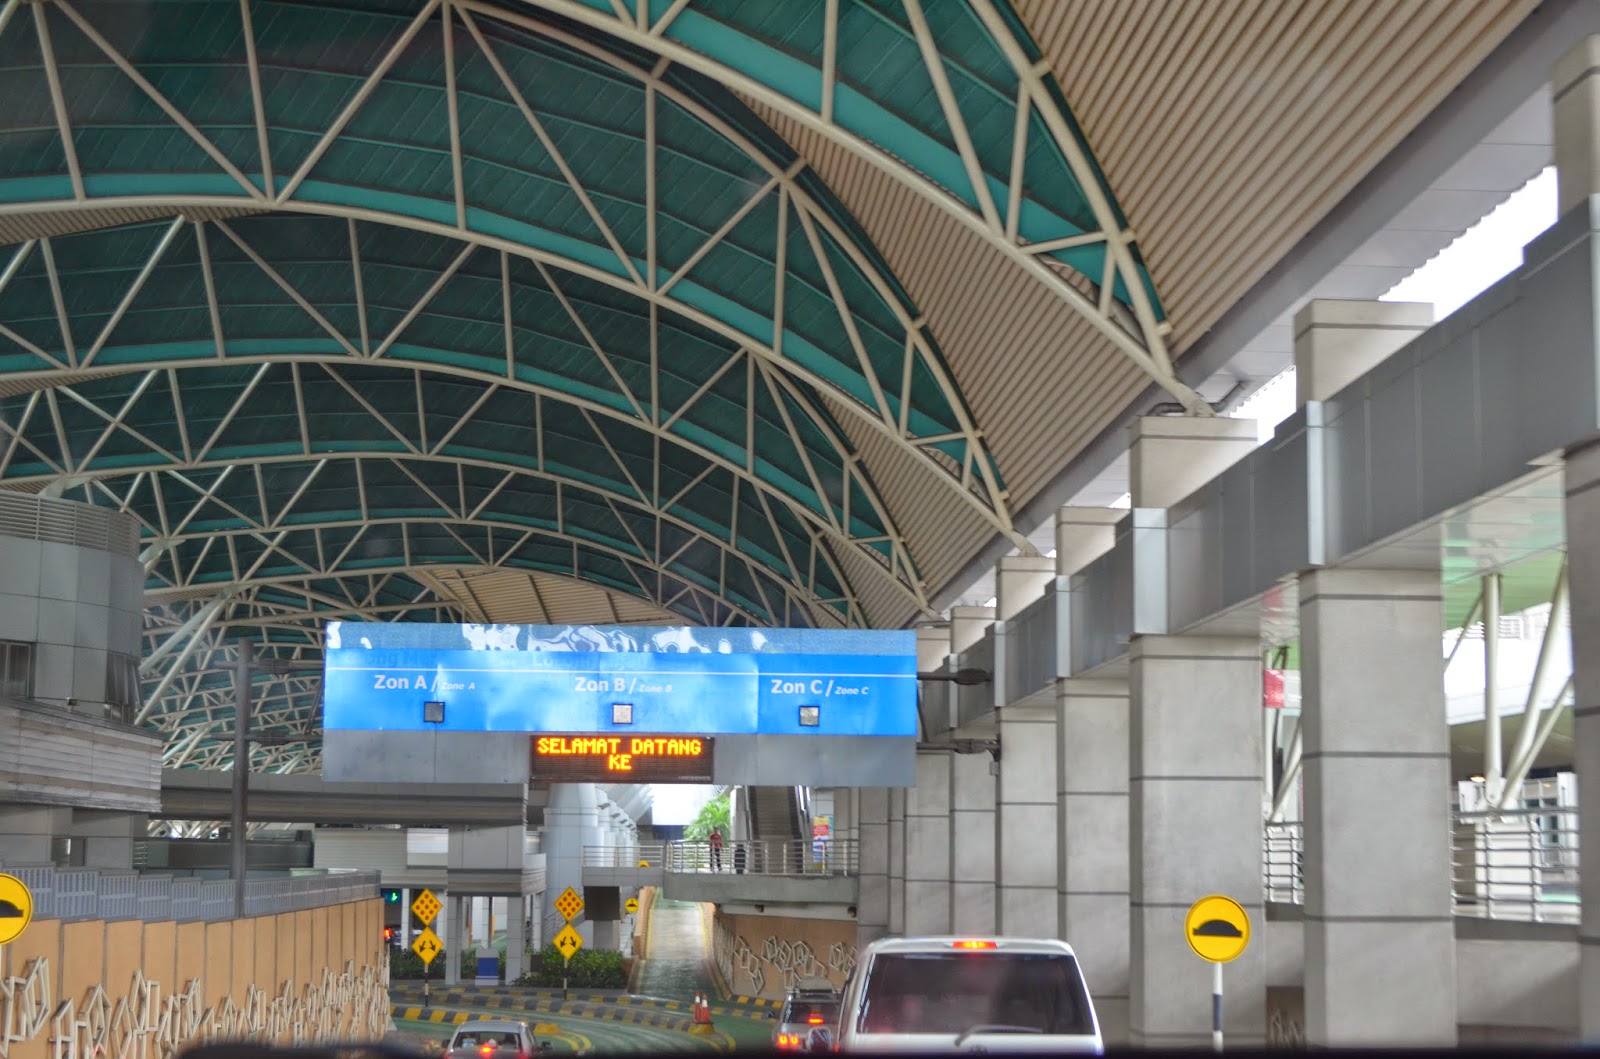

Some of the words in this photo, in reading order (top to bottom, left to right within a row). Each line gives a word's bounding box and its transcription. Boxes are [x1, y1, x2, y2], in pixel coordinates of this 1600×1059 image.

[374, 674, 409, 689] Zon
[414, 675, 427, 689] A
[575, 677, 609, 692] Zon
[614, 678, 625, 691] B
[639, 684, 662, 692] Zone
[771, 679, 805, 694] Zon
[810, 679, 822, 694] C
[835, 686, 859, 695] Zone
[861, 686, 869, 695] C
[538, 738, 621, 754] SELAMAT
[631, 739, 702, 755] DATANG
[608, 754, 632, 770] KE
